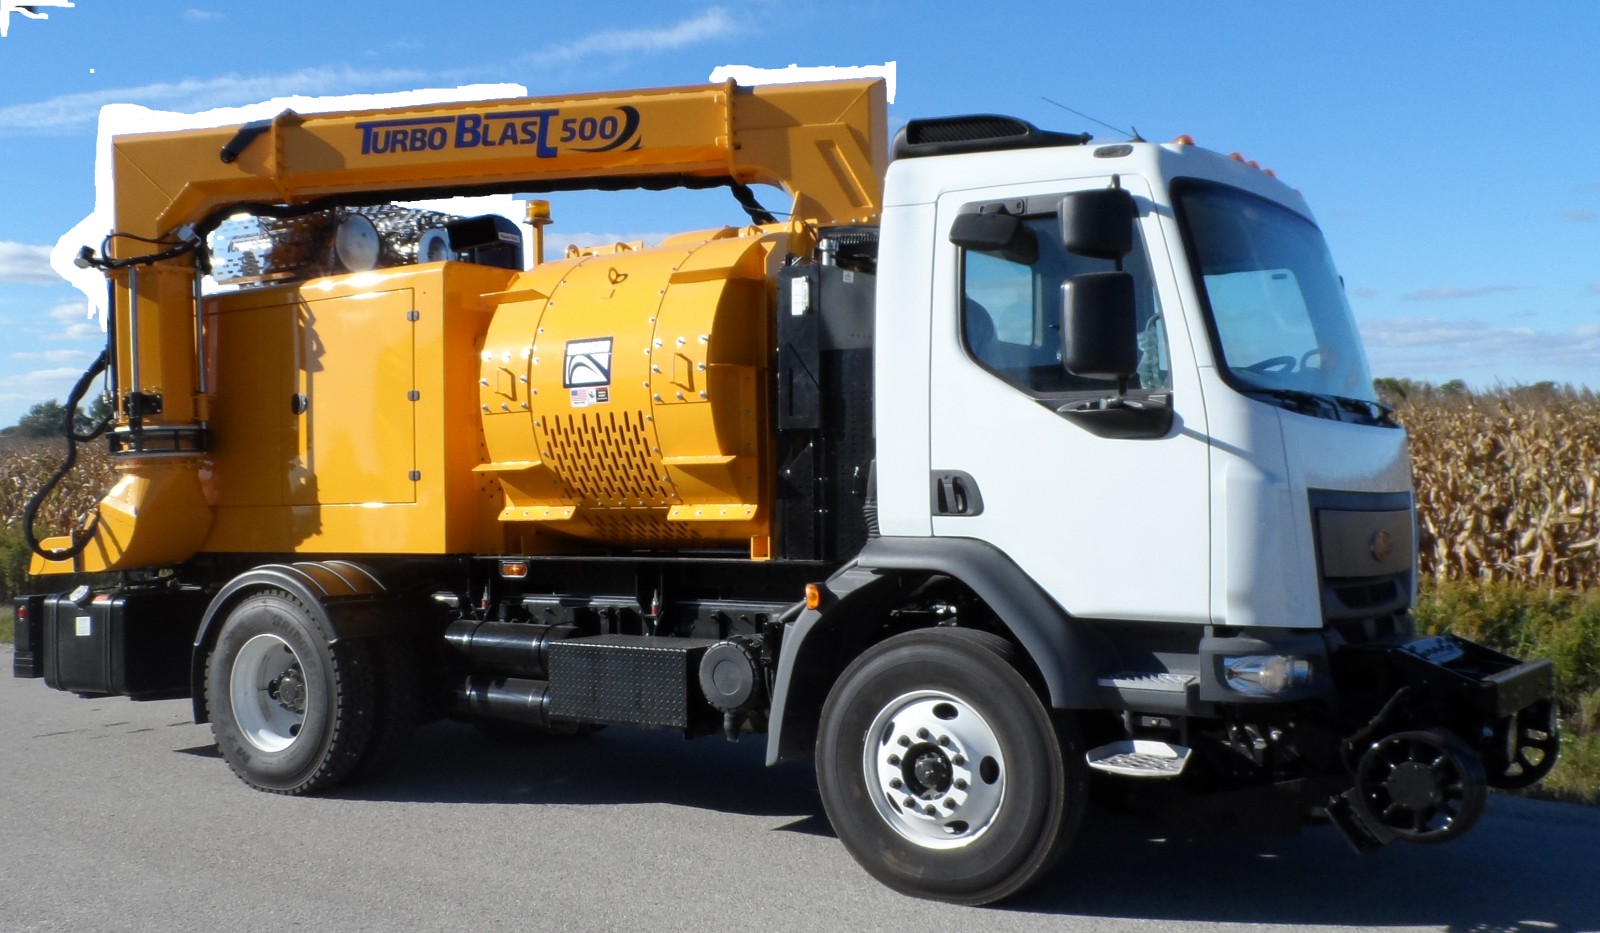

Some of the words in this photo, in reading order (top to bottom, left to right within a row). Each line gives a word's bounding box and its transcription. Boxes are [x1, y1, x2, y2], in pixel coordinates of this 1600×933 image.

[355, 115, 456, 154] TURBO
[454, 109, 560, 158] BLAST
[560, 116, 618, 142] 500
